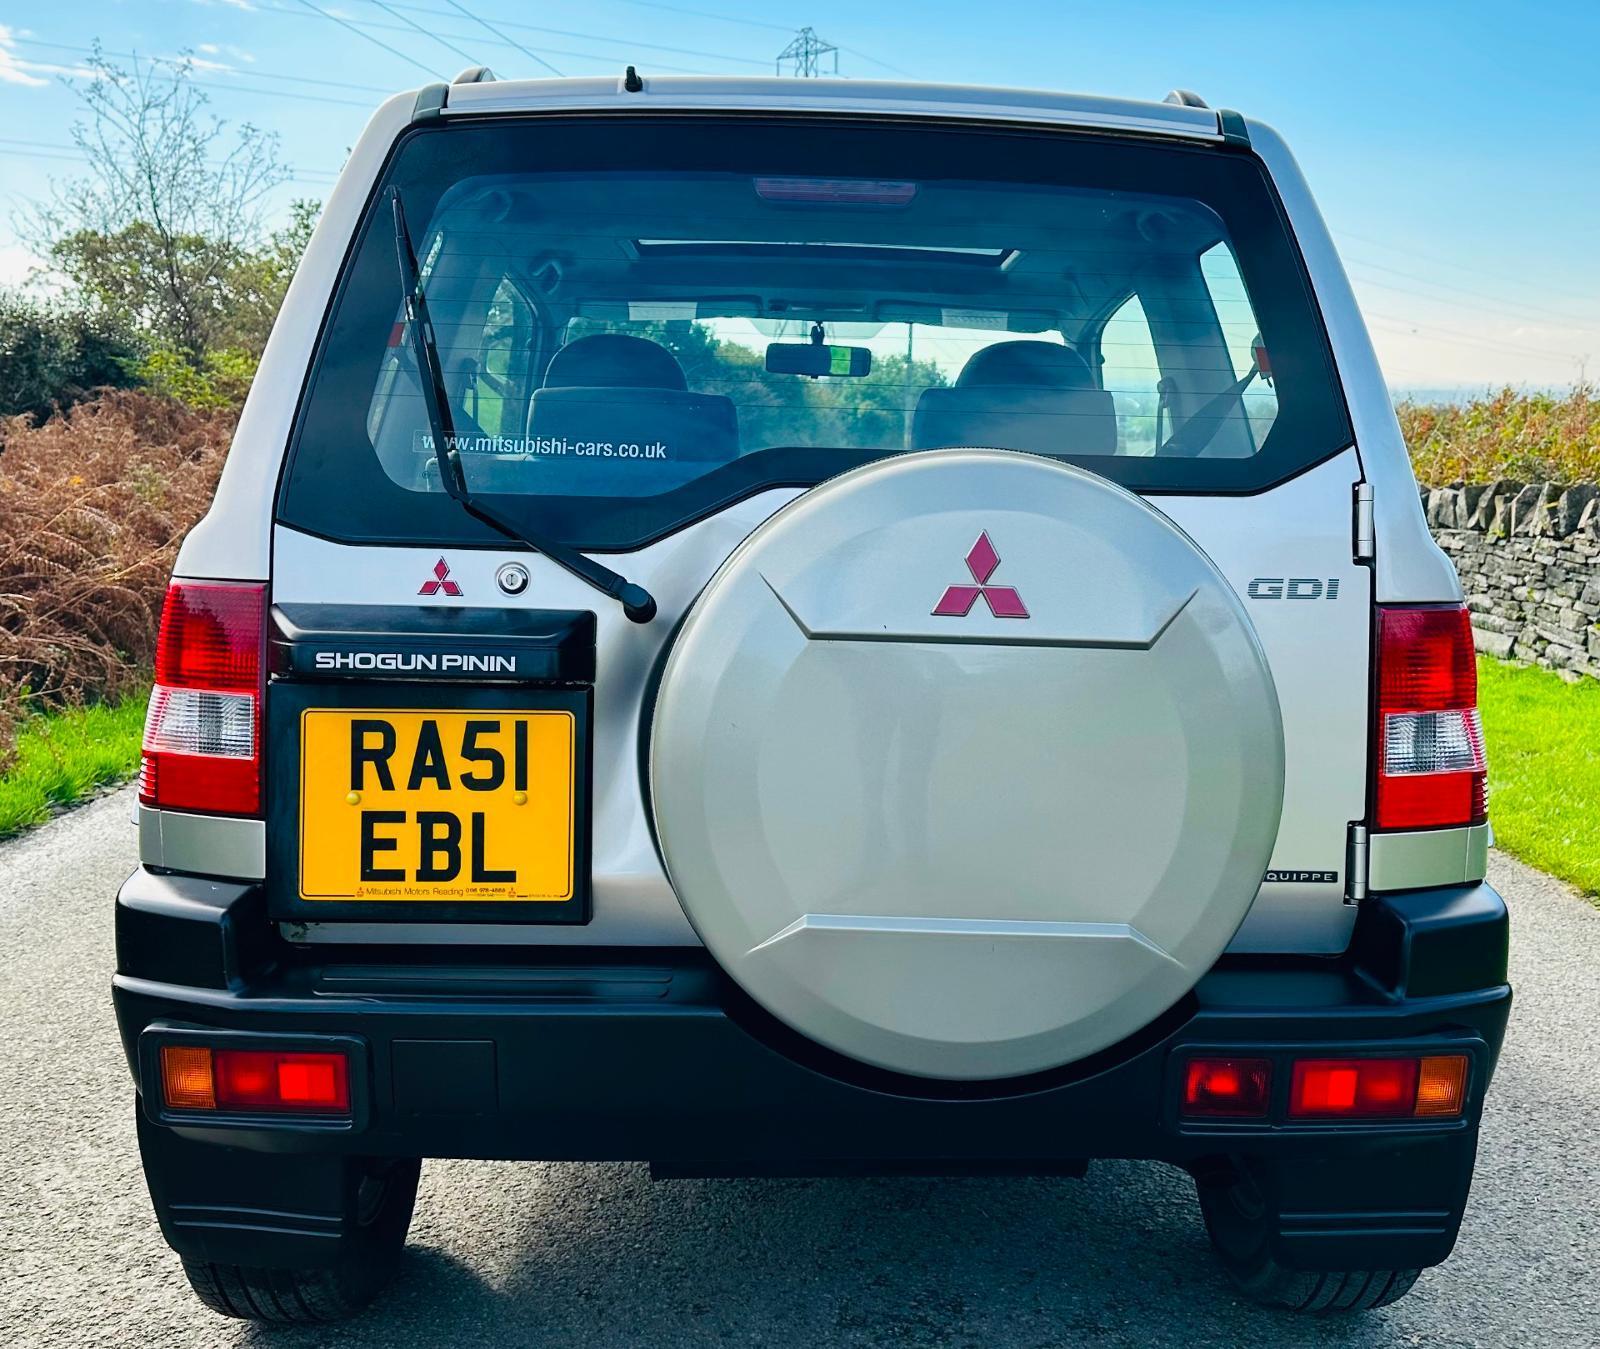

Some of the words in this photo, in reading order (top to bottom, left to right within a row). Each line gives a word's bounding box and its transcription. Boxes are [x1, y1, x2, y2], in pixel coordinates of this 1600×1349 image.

[1247, 578, 1340, 600] GDI
[315, 652, 437, 670] SHOGUN
[442, 654, 516, 672] PININ
[350, 719, 528, 791] RA51
[360, 811, 517, 883] EBL
[1265, 872, 1334, 881] QUIPPE
[366, 887, 402, 896] Mitsubishi
[404, 887, 430, 896] Motors
[432, 887, 464, 897] Reading
